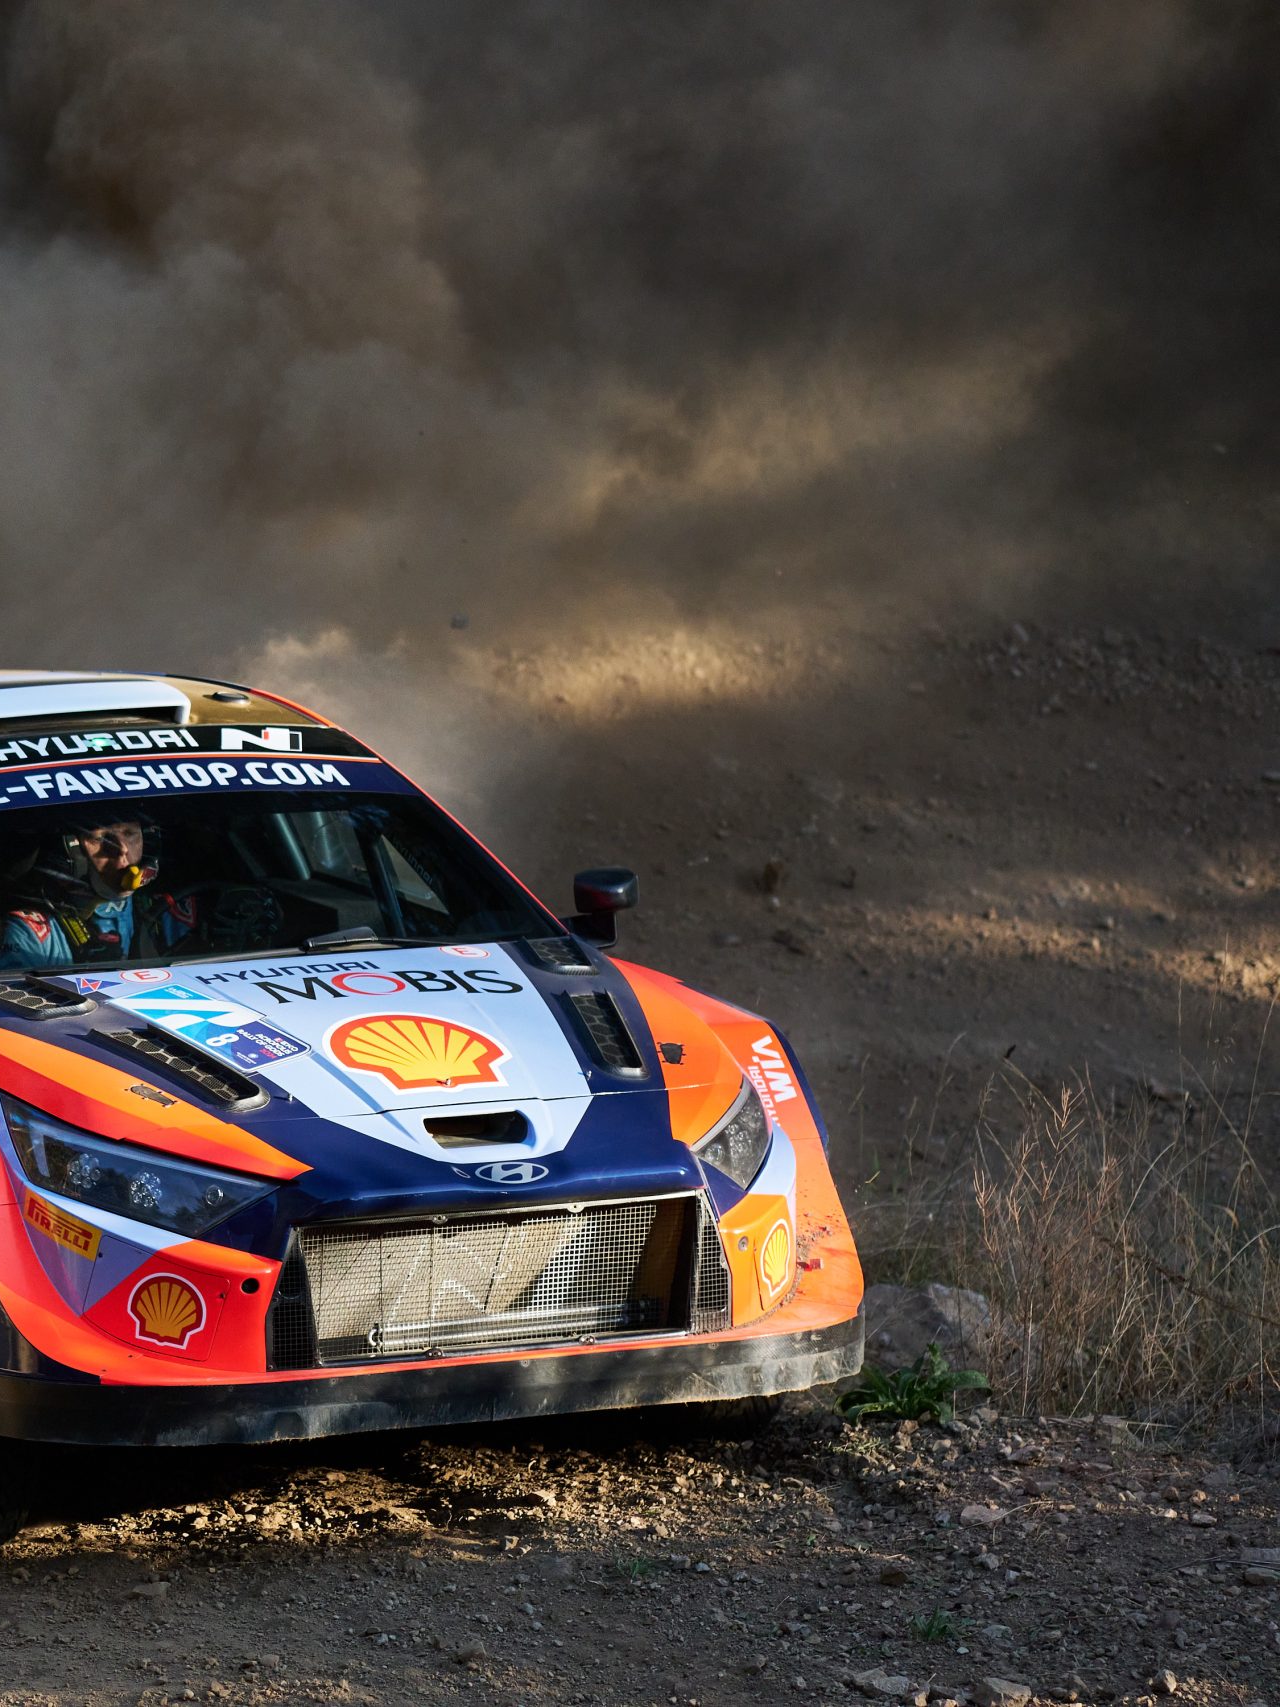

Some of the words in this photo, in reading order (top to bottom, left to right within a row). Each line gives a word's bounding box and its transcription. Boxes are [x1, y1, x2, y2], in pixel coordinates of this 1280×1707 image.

[196, 961, 381, 985] HYUNDAI
[252, 969, 524, 1004] MOBIS
[751, 1035, 798, 1103] WIA
[27, 1197, 93, 1252] PIRELLI
